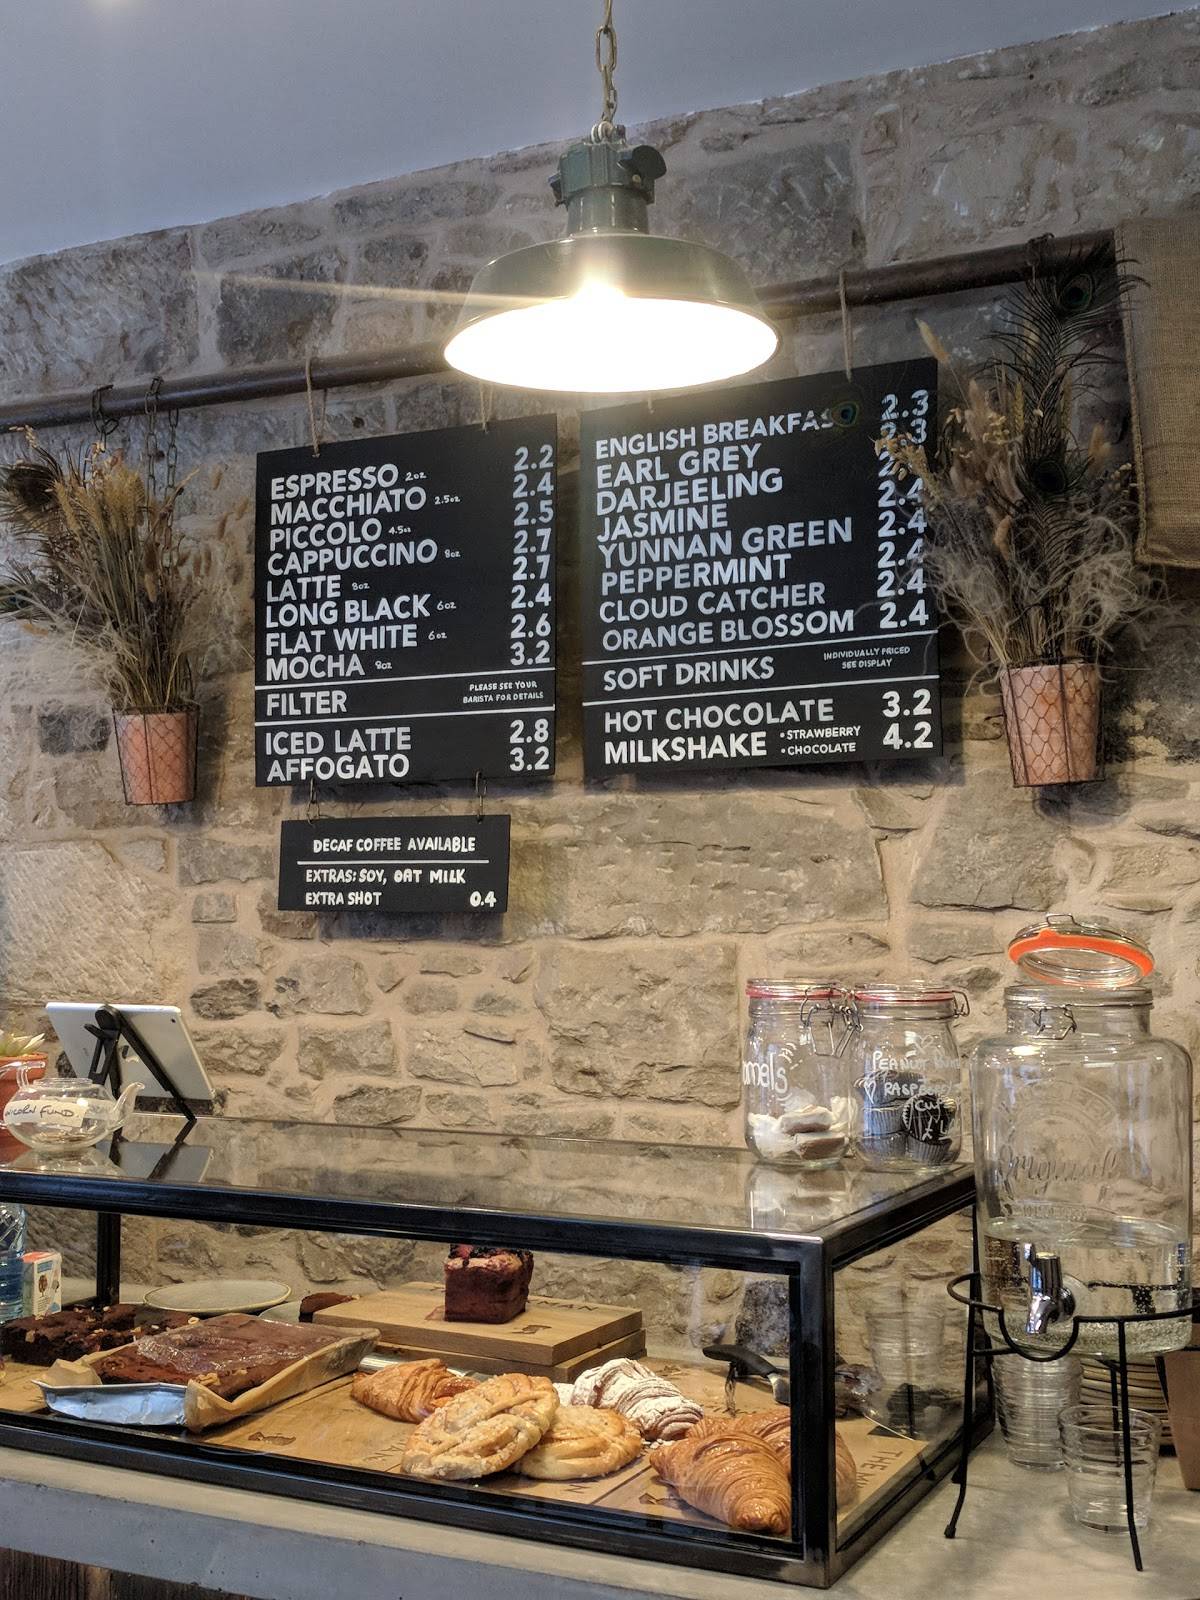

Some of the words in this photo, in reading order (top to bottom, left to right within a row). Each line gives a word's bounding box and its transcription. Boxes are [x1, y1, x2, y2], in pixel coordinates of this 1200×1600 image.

[596, 427, 696, 460] ENGLISH
[703, 411, 833, 444] BREAKFAS
[882, 390, 928, 420] 2.3
[272, 464, 398, 500] ESPRESSO
[514, 444, 553, 471] 2.2
[596, 456, 669, 489] EARL
[679, 443, 761, 476] GREY
[271, 487, 426, 525] MACCHIATO
[513, 472, 554, 498] 2.4
[596, 468, 782, 516] DARJEELING
[597, 503, 727, 542] JASMINE
[878, 477, 923, 508] 2.4
[270, 518, 382, 551] PICCOLO
[514, 500, 553, 526] 2.5
[598, 531, 731, 568] YUNNAN
[742, 517, 851, 553] GREEN
[878, 508, 927, 537] 2.4
[268, 539, 437, 576] CAPPUCCINO
[514, 528, 551, 553] 2.7
[602, 554, 791, 595] PEPPERMINT
[877, 539, 924, 569] 2.4
[267, 575, 341, 602] LATTE
[513, 554, 550, 580] 2.7
[600, 596, 687, 623] CLOUD
[698, 582, 825, 614] CATCHER
[877, 569, 926, 598] 2.4
[266, 601, 338, 628] LONG
[345, 594, 430, 623] BLACK
[511, 583, 551, 609] 2.4
[603, 622, 713, 651] ORANGE
[721, 610, 853, 642] BLOSSOM
[880, 600, 929, 628] 2.4
[266, 630, 325, 655] FLAT
[333, 624, 417, 651] WHITE
[511, 613, 551, 638] 2.6
[824, 648, 880, 660] INDIVIDUALLY
[882, 646, 910, 655] PRICED
[267, 654, 365, 681] MOCHA
[511, 640, 550, 665] 3.2
[604, 664, 667, 691] SOFT
[676, 656, 774, 685] DRINKS
[842, 661, 857, 669] SEE
[859, 659, 892, 668] DISPLAY
[267, 690, 347, 716] FILTER
[463, 695, 493, 703] BARISTA
[513, 692, 544, 700] DETAILS
[470, 683, 497, 691] PLEASE
[500, 682, 512, 690] SEE
[515, 681, 537, 689] YOUR
[605, 710, 657, 733] HOT
[666, 699, 833, 730] CHOCOLATE
[882, 689, 931, 717] 3.2
[266, 731, 324, 755] ICED
[335, 727, 411, 753] LATTE
[510, 719, 548, 743] 2.8
[605, 731, 767, 764] MILKSHAKE
[786, 726, 861, 740] STRAWBERRY
[883, 721, 933, 749] 4.2
[788, 743, 856, 755] CHOCOLATE
[267, 754, 409, 782] AFFOGATO
[510, 746, 549, 771] 3.2
[313, 839, 353, 853] DECAF
[356, 837, 401, 852] COFFEE
[408, 836, 475, 852] AVAILABLE
[306, 869, 357, 883] EXTRAS:
[359, 869, 387, 885] SOY,
[394, 868, 422, 883] OAT
[430, 869, 465, 884] MILK
[306, 891, 344, 905] EXTRA
[348, 891, 382, 905] SHOT
[470, 891, 496, 907] 0.4
